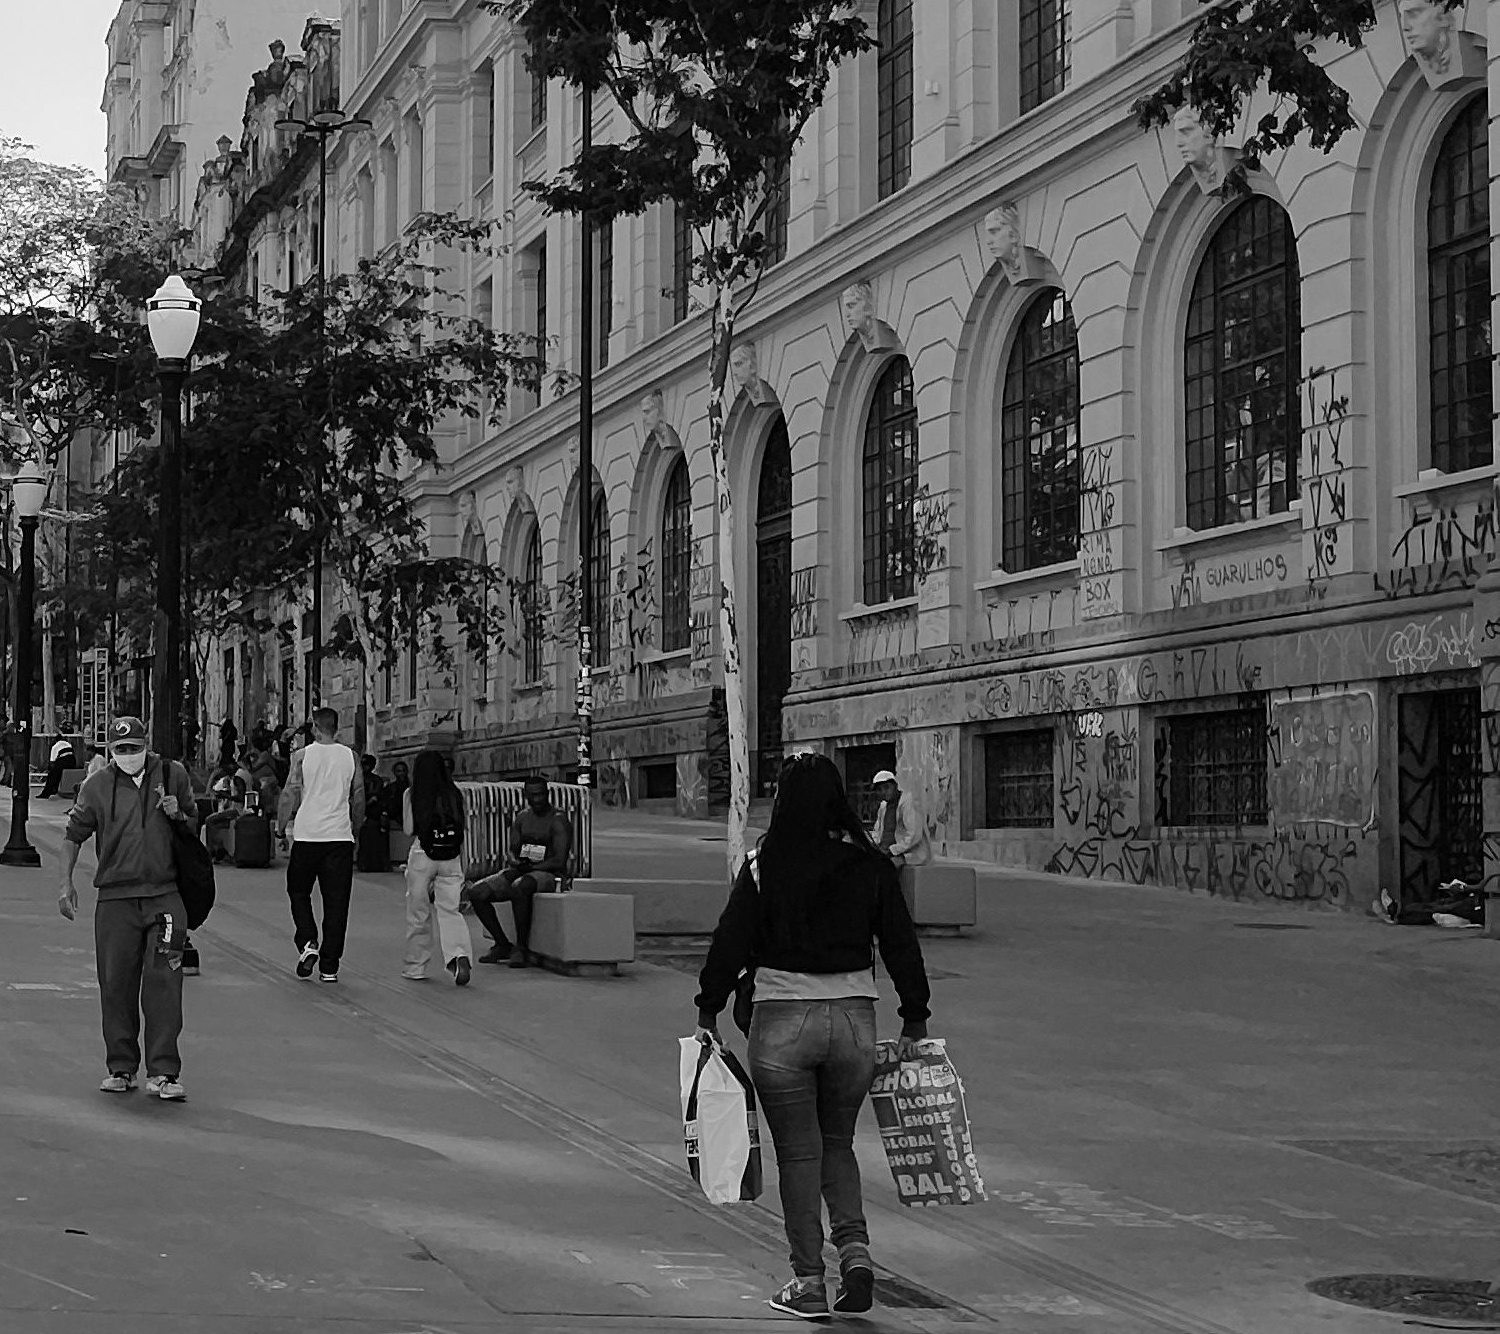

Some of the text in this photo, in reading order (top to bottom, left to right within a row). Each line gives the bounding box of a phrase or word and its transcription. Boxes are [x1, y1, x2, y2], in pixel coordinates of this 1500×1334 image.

[1206, 554, 1287, 587] GUARULHOS
[1085, 578, 1112, 602] BOX
[898, 1091, 957, 1110] GLOBAL
[903, 1110, 952, 1128] SHOES
